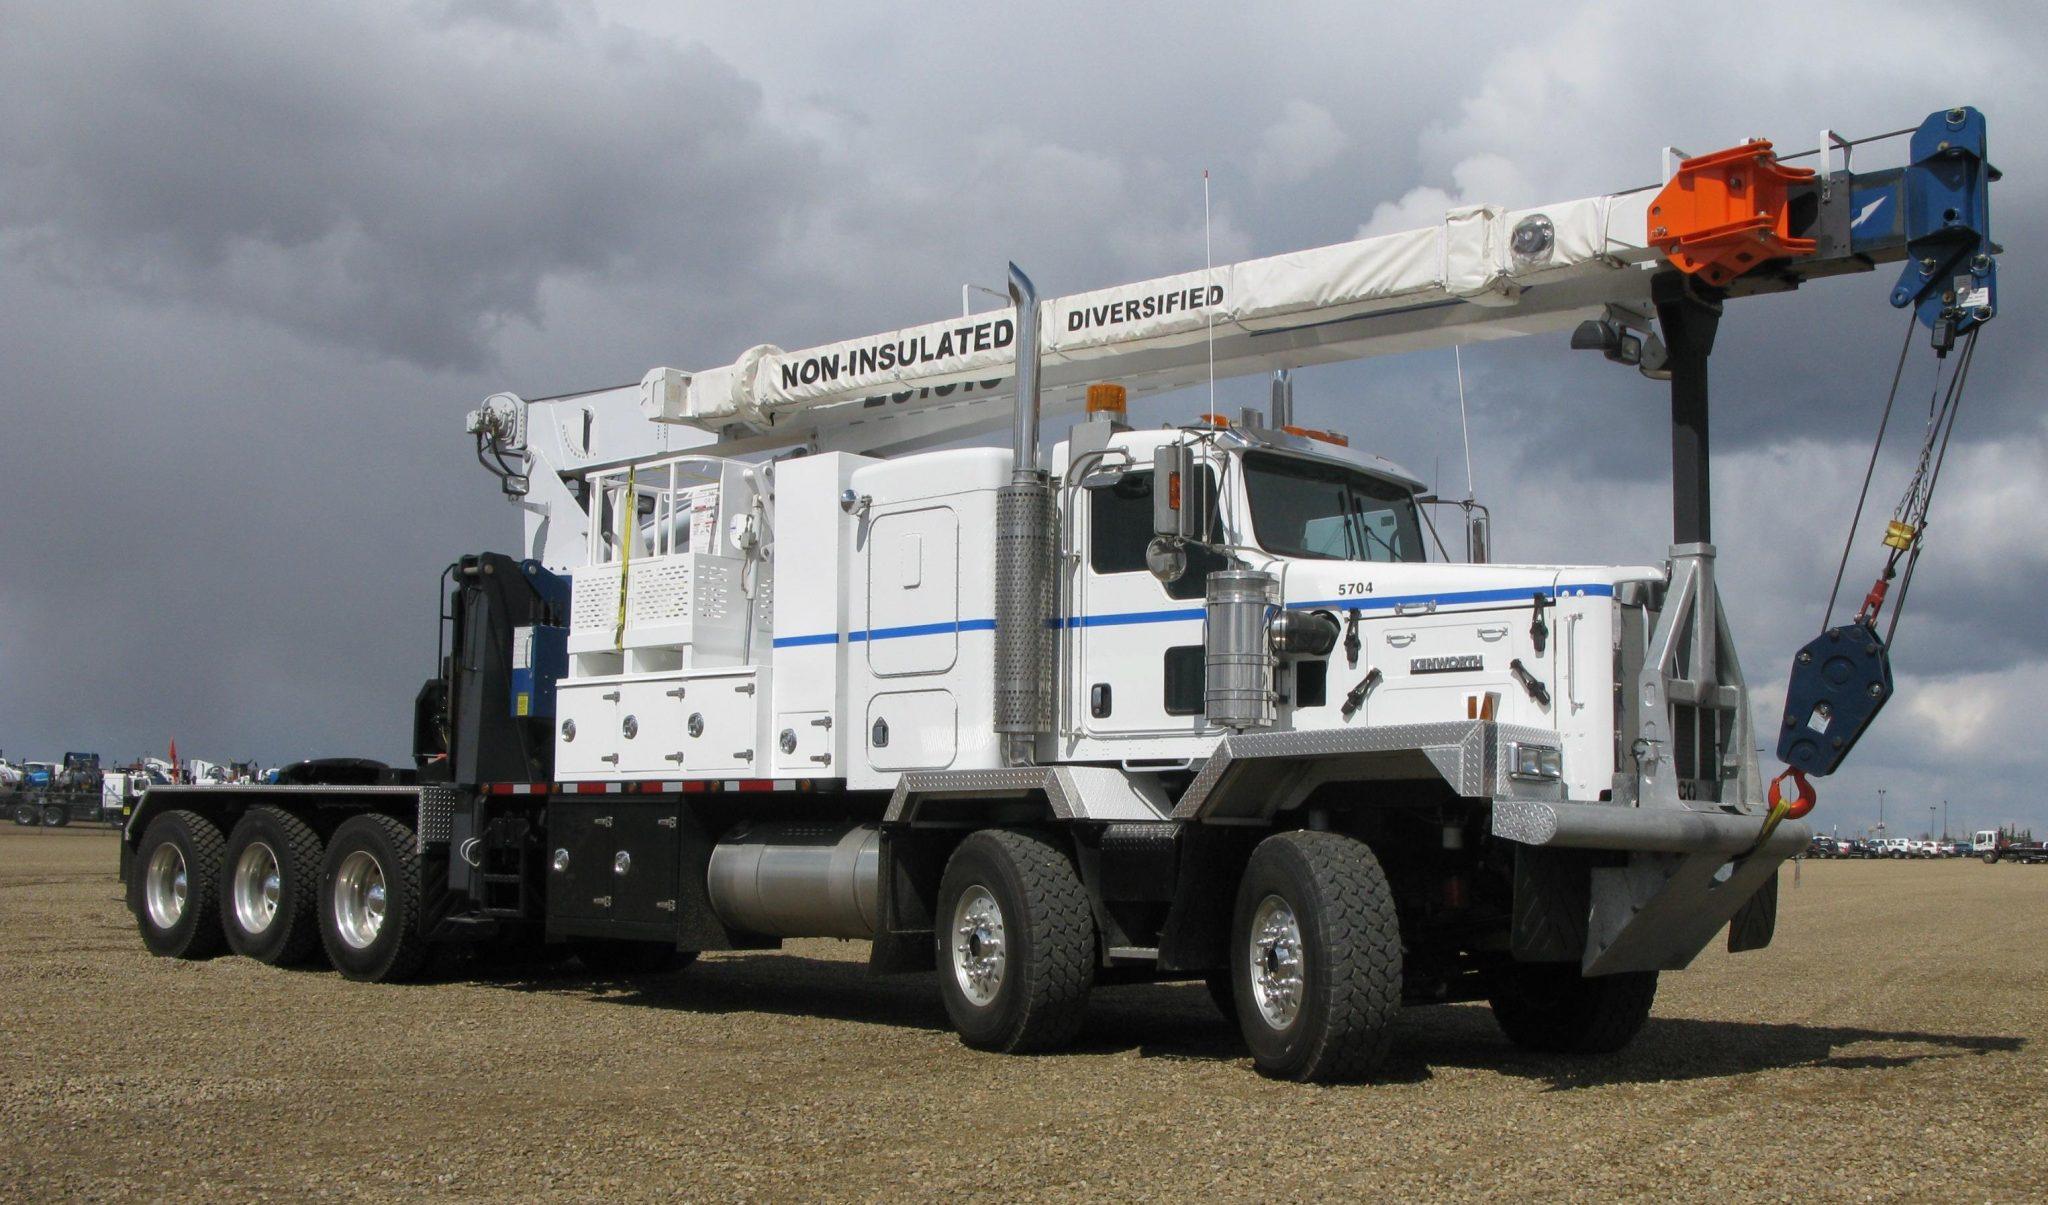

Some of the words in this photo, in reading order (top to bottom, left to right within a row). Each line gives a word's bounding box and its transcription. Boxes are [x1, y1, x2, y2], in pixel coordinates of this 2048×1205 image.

[1067, 284, 1225, 332] DIVERSIFIED
[782, 318, 1014, 390] NON-INSULATED
[1338, 581, 1374, 596] 5704
[1409, 655, 1484, 672] KENWORTH
